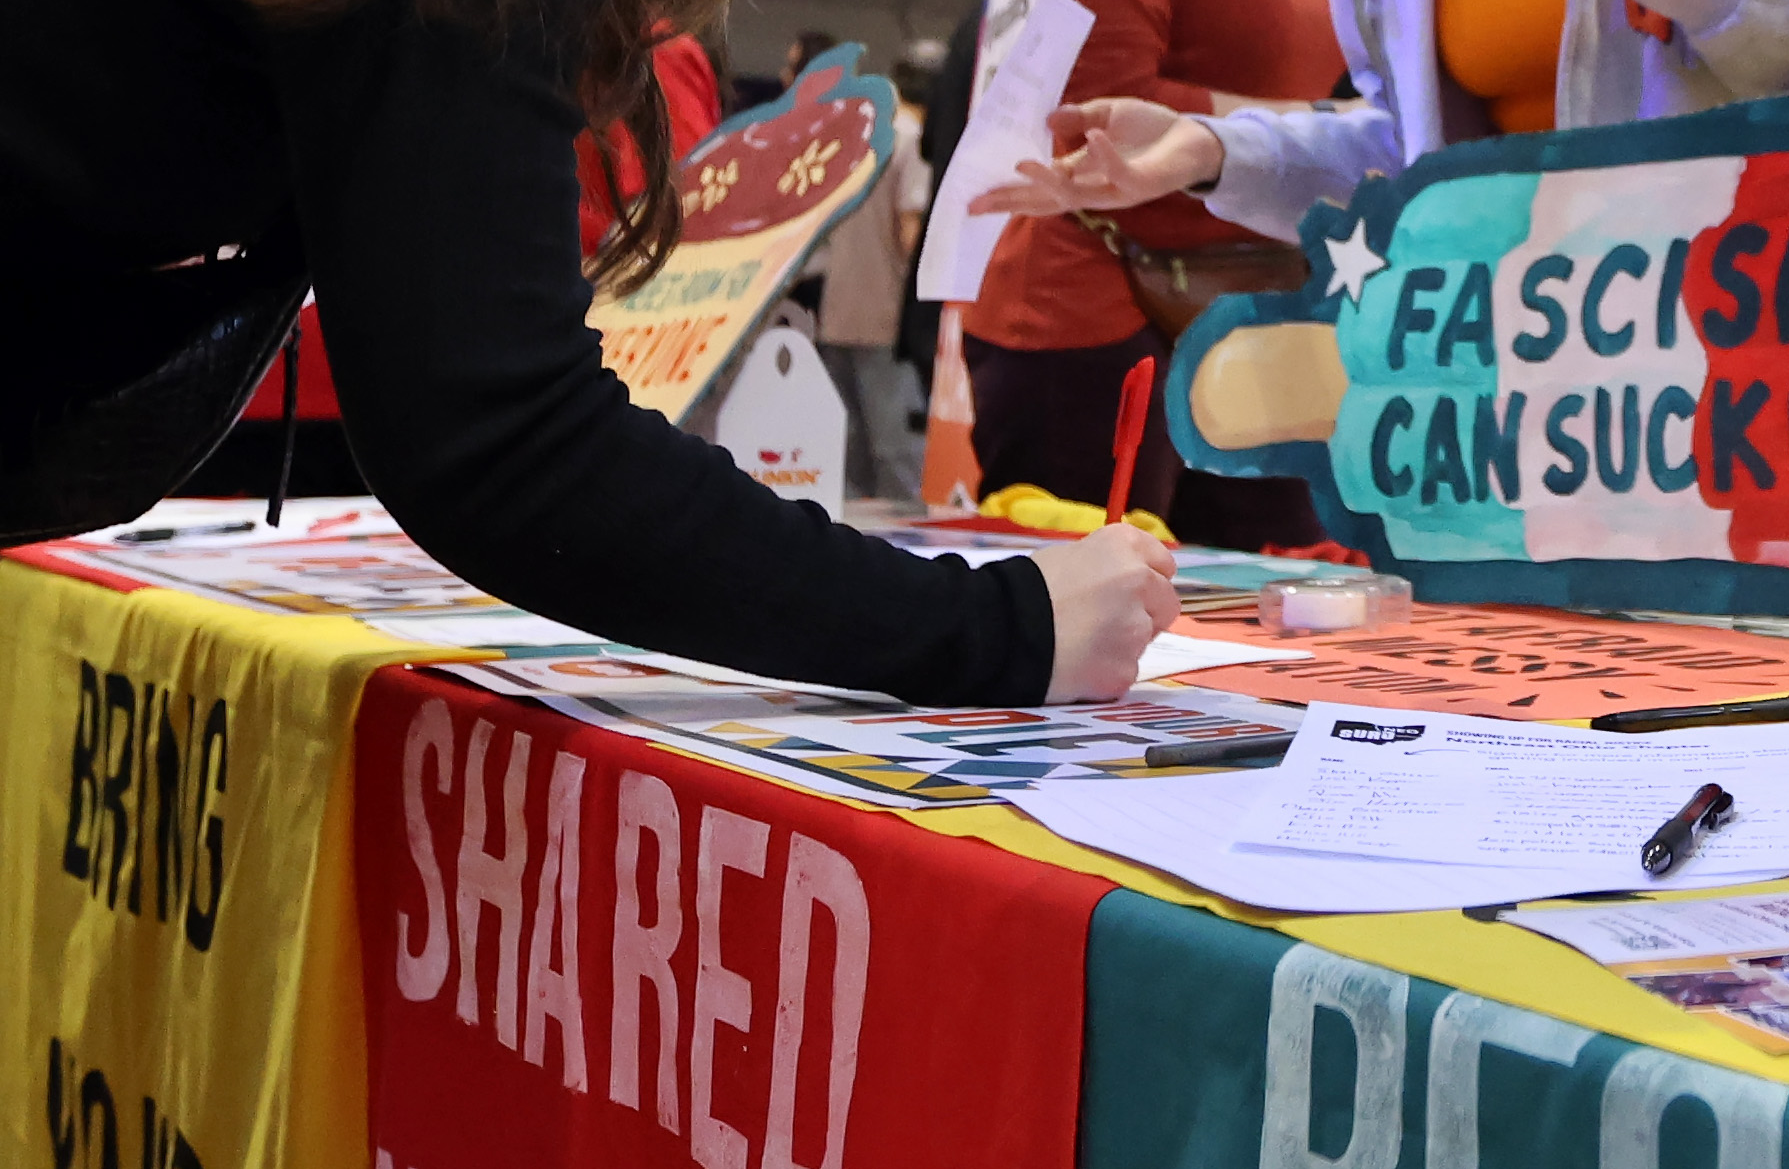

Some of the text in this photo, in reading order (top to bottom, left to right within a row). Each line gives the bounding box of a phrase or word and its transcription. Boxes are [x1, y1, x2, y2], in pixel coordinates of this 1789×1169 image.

[1370, 389, 1527, 505] CAN
[1542, 378, 1777, 496] SUCK
[1445, 731, 1505, 739] SHOWING
[1445, 737, 1557, 748] Northeast
[62, 658, 230, 954] BRING
[397, 698, 872, 1169] SHARED
